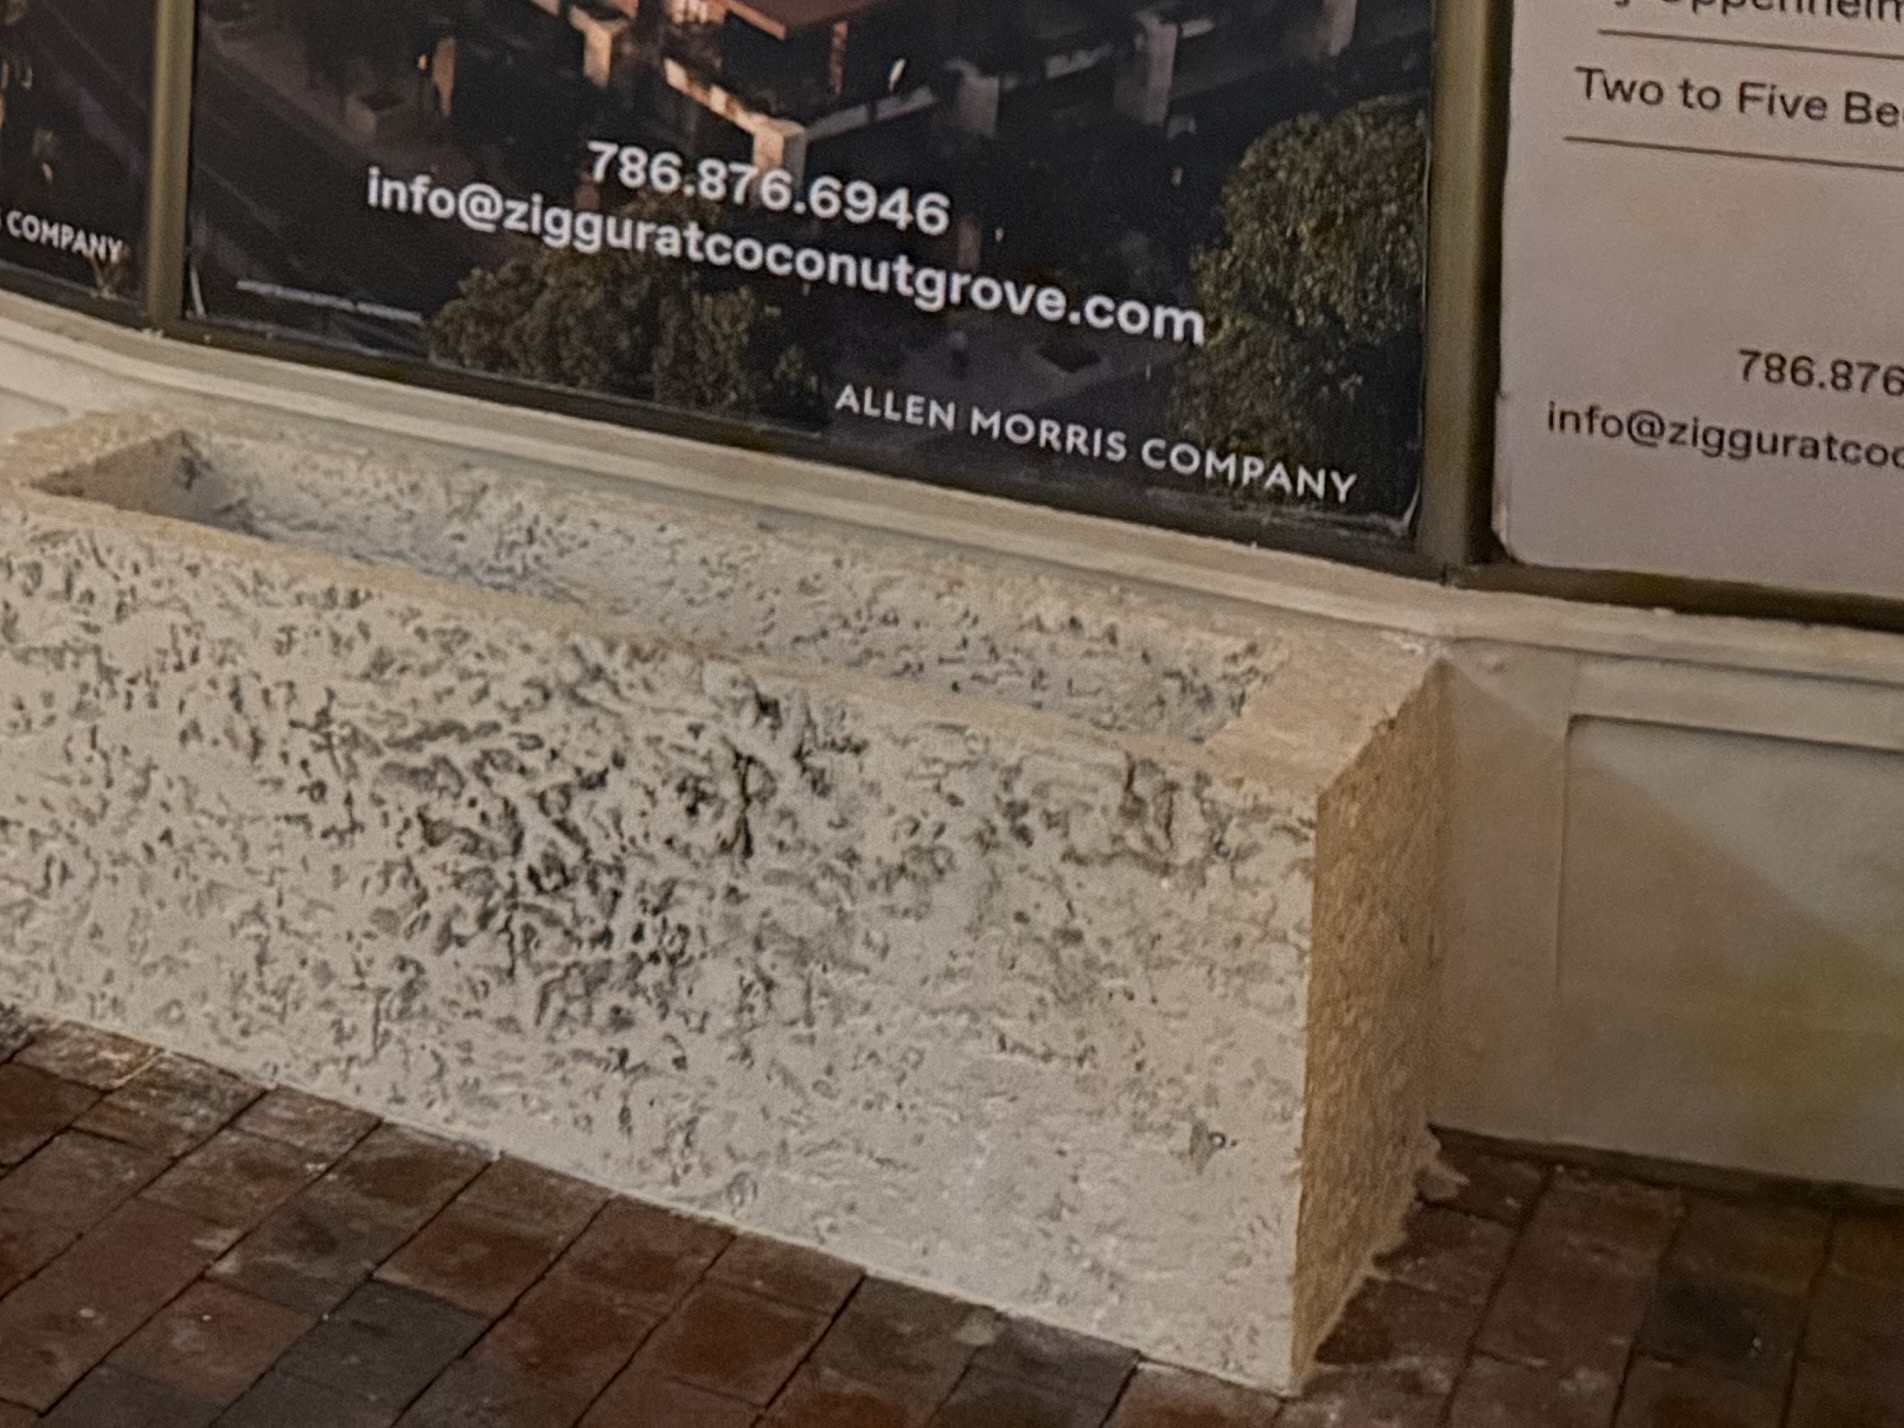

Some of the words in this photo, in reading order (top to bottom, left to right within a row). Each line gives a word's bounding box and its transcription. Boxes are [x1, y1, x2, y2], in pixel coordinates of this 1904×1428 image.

[1574, 66, 1664, 106] Two
[1678, 77, 1721, 111] to
[1738, 81, 1828, 121] Five
[1844, 90, 1904, 129] Be
[588, 142, 950, 236] 786.876.6946
[6, 209, 123, 264] COMPANY
[366, 165, 1205, 345] info@zigguratcoconutgrove.com
[835, 383, 956, 431] ALLEN
[971, 406, 1127, 463] MORRIS
[1141, 437, 1358, 504] COMPANY
